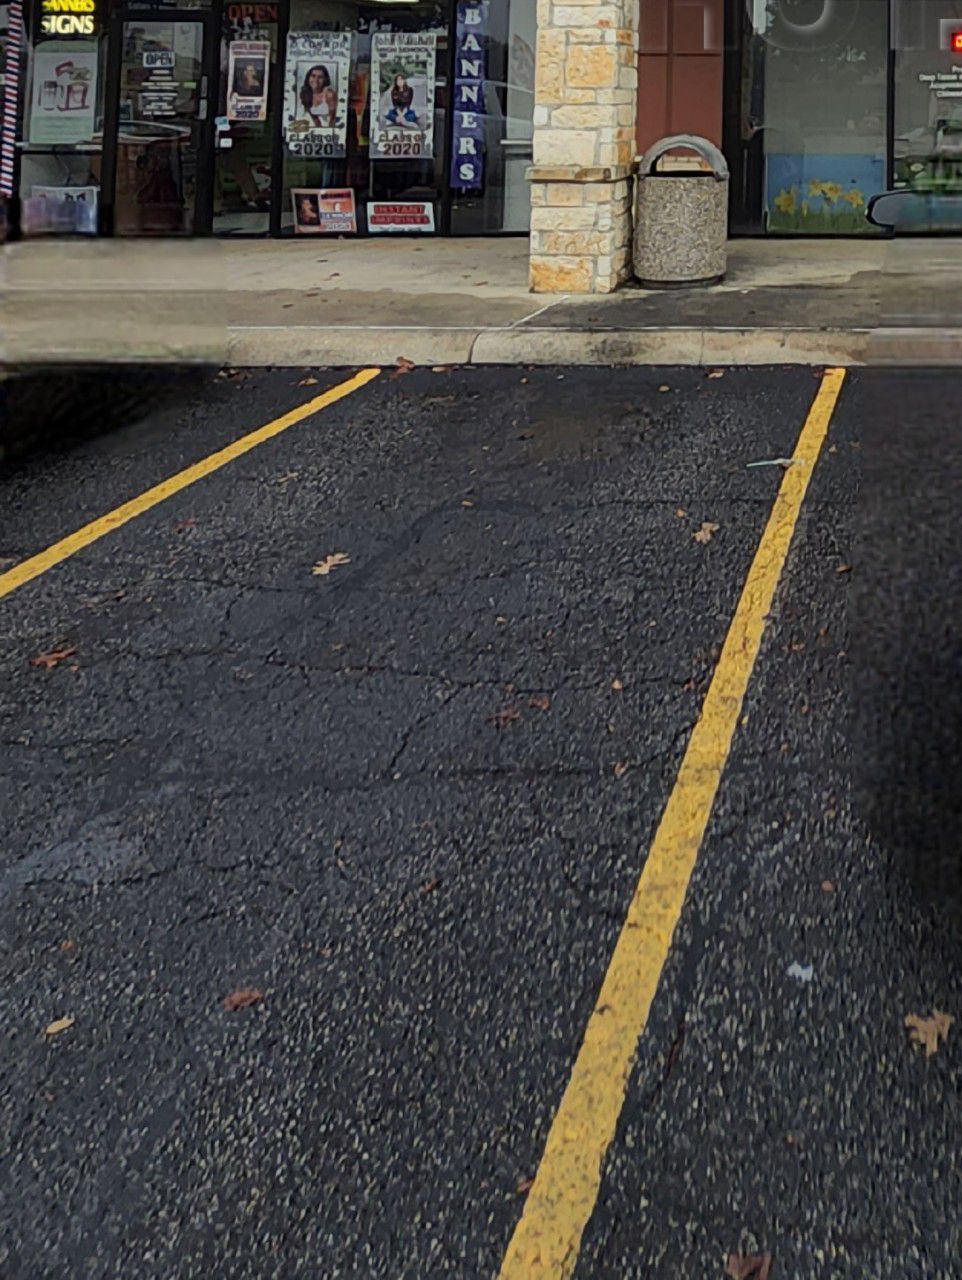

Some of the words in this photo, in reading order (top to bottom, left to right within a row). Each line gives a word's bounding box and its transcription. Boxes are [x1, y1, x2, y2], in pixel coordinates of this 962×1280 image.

[40, 15, 95, 34] SIGNS
[145, 52, 173, 66] OPEN
[458, 7, 483, 181] BANNERS
[293, 143, 334, 156] 2020
[383, 143, 421, 156] 2020
